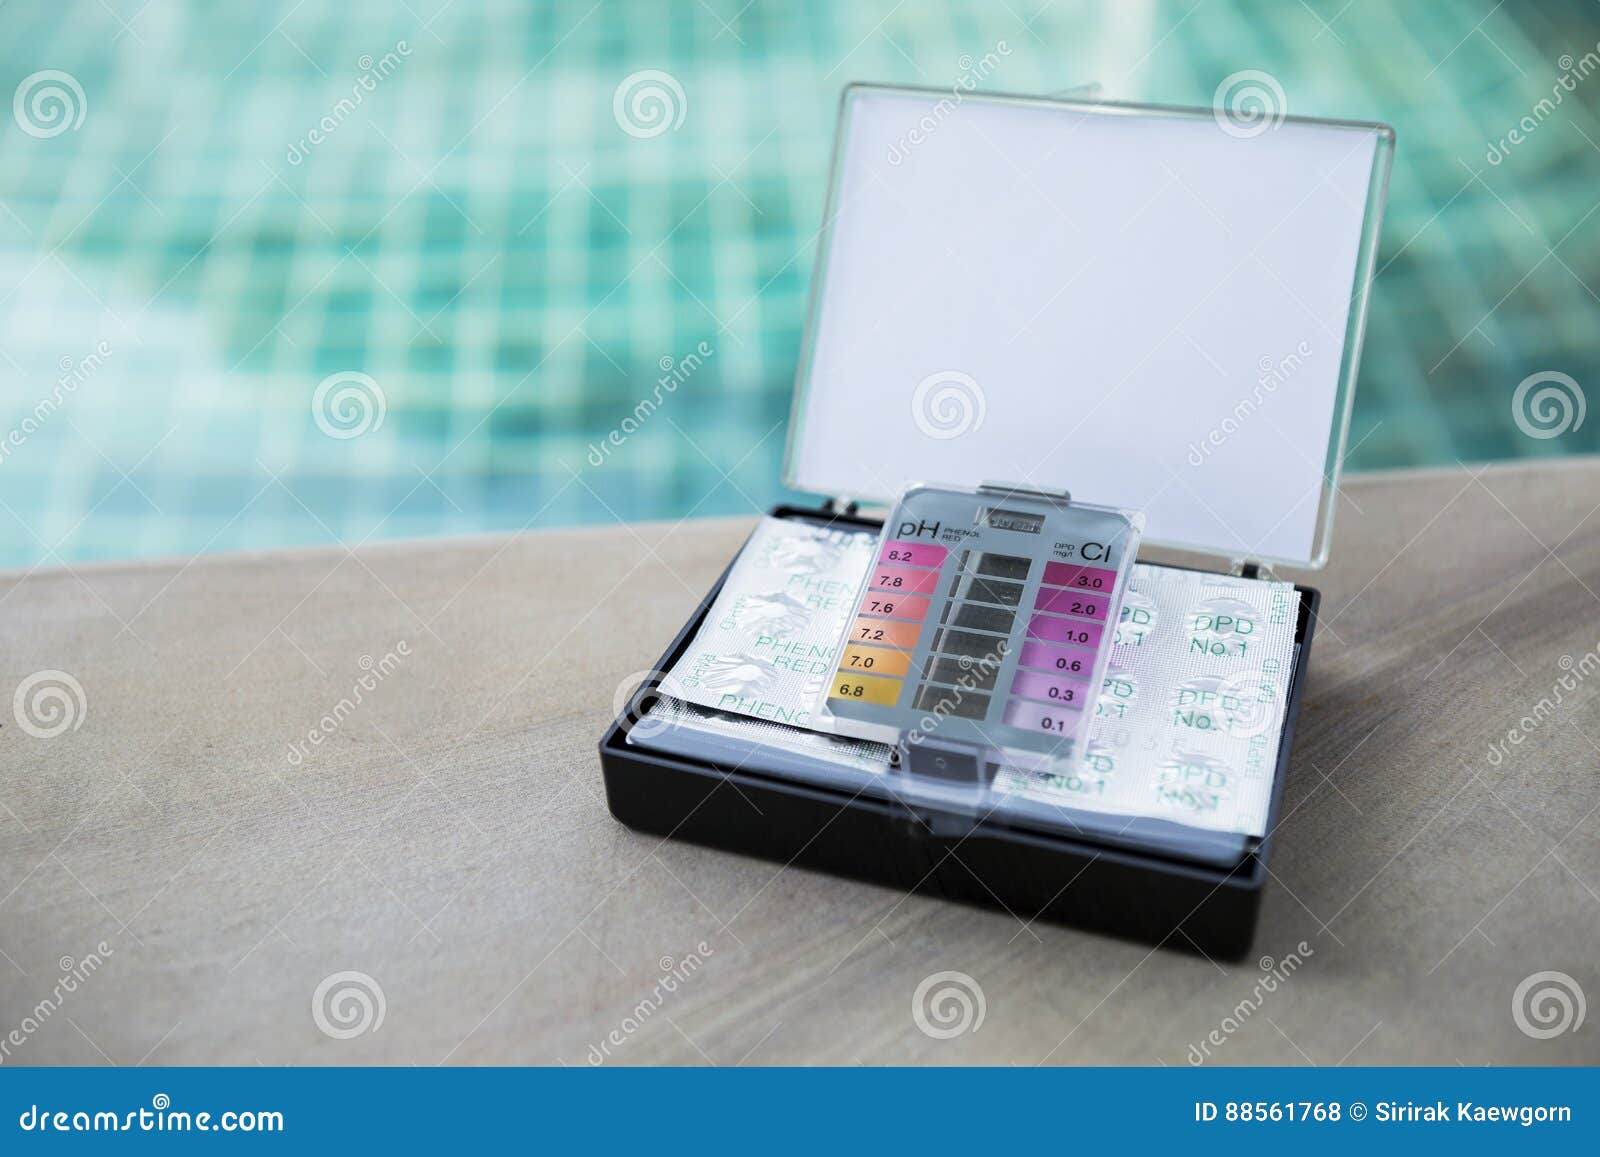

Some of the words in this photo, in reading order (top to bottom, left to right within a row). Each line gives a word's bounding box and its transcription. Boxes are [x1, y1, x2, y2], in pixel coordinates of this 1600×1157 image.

[896, 519, 941, 540] pH
[943, 527, 980, 538] PHENOL
[942, 534, 961, 542] RED
[1053, 549, 1073, 558] mg/l
[1054, 542, 1075, 551] DPD
[888, 550, 913, 563] 8.2
[880, 575, 904, 588] 7.8
[1078, 575, 1103, 589] 3.0
[870, 600, 894, 614] 7.6
[1071, 602, 1096, 616] 2.0
[1193, 614, 1255, 635] DPD
[860, 627, 885, 641] 7.2
[1066, 630, 1089, 644] 1.0
[754, 635, 836, 659] PHEN
[850, 655, 875, 668] 7.0
[1056, 657, 1081, 672] 0.6
[838, 683, 864, 697] 6.8
[1048, 687, 1074, 702] 0.3
[1041, 717, 1064, 732] 0.1
